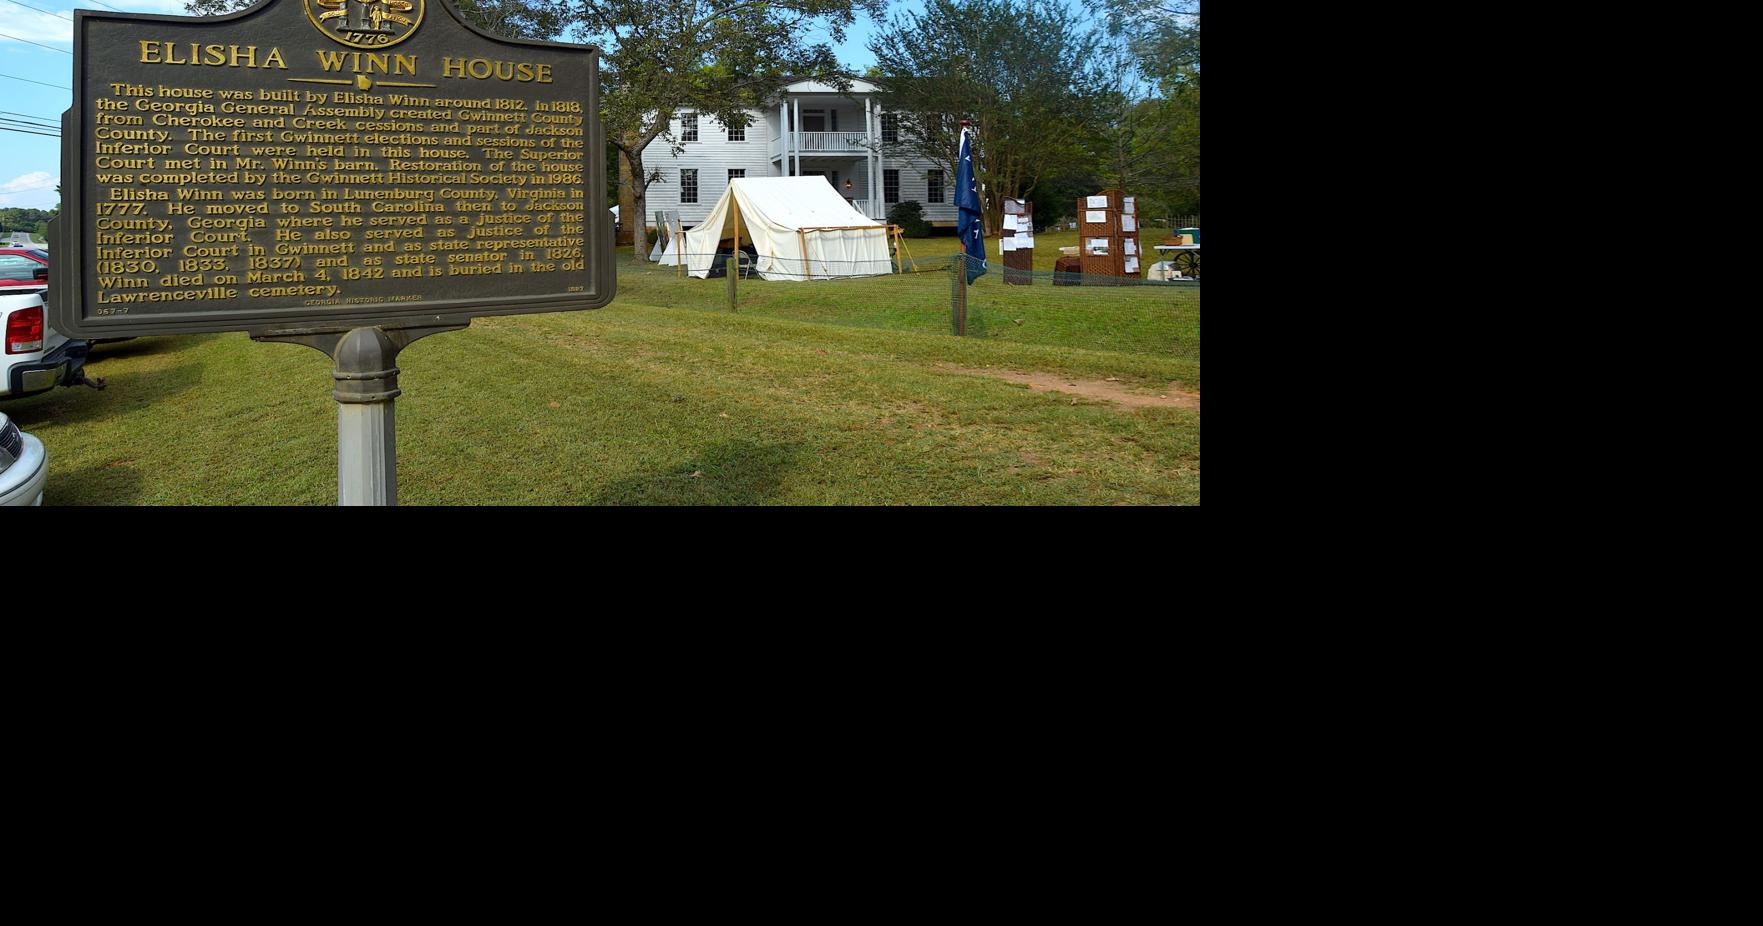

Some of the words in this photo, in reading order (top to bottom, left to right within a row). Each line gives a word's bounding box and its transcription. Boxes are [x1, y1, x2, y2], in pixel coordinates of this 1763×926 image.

[344, 32, 388, 44] 1776
[139, 40, 288, 69] ELISHA
[316, 50, 417, 76] WINN
[443, 57, 553, 83] HOUSE
[110, 83, 153, 97] This
[160, 85, 213, 98] house
[219, 90, 252, 100] was
[259, 89, 300, 102] built
[306, 91, 327, 104] by
[334, 92, 383, 105] Elisha
[389, 94, 431, 107] Winn
[435, 97, 491, 109] around
[496, 99, 527, 111] 1812.
[536, 101, 551, 111] In
[96, 98, 127, 111] the
[136, 100, 214, 115] Georgia
[221, 102, 294, 115] General
[303, 104, 384, 120] Assembly
[390, 108, 451, 120] created
[458, 110, 527, 123] Gwinnett
[532, 112, 583, 127] County
[96, 112, 143, 125] from
[152, 114, 245, 128] Cherokee
[252, 116, 285, 128] and
[293, 117, 346, 129] Creek
[356, 120, 424, 132] cessions
[431, 121, 459, 133] and
[467, 123, 499, 135] part
[505, 124, 520, 135] of
[526, 125, 583, 136] Jackson
[96, 128, 173, 143] County.
[188, 129, 225, 141] The
[232, 130, 273, 142] first
[280, 131, 359, 144] Gwinnett
[364, 133, 438, 145] elections
[443, 134, 471, 146] and
[477, 135, 535, 147] sessions
[540, 136, 555, 147] of
[561, 138, 583, 148] the
[96, 141, 172, 155] Inferior
[185, 143, 239, 156] Court
[253, 146, 295, 156] were
[307, 144, 344, 157] held
[354, 146, 370, 158] in
[382, 147, 410, 158] this
[420, 148, 469, 159] house.
[483, 149, 513, 159] The
[521, 150, 583, 162] Superior
[96, 156, 155, 169] Court
[165, 158, 200, 169] met
[210, 158, 227, 170] in
[236, 158, 264, 170] Mr.
[272, 158, 327, 170] Winn's
[334, 159, 378, 171] barn.
[390, 159, 481, 172] Restoration
[490, 162, 506, 172] of
[512, 162, 535, 172] the
[542, 162, 583, 172] house
[96, 173, 134, 183] was
[140, 172, 239, 185] completed
[244, 172, 266, 186] by
[272, 172, 300, 183] the
[306, 172, 384, 184] Gwinnett
[388, 172, 465, 185] Historical
[470, 174, 526, 186] Society
[531, 174, 544, 184] in
[548, 174, 584, 184] 1986.
[110, 188, 169, 201] Elisha
[177, 188, 223, 200] Winn
[232, 190, 264, 200] was
[272, 188, 316, 200] born
[321, 189, 337, 200] in
[343, 188, 434, 202] Lunenburg
[440, 189, 497, 201] County,
[506, 188, 565, 201] Virginia
[571, 188, 583, 198] in
[96, 202, 147, 216] 1777.
[168, 203, 195, 215] He
[206, 202, 268, 214] moved
[281, 203, 299, 214] to
[310, 201, 361, 214] South
[372, 201, 444, 213] Carolina
[456, 201, 492, 212] then
[502, 202, 516, 211] to
[526, 200, 583, 212] Jackson
[96, 217, 173, 231] County,
[187, 217, 266, 231] Georgia
[277, 216, 333, 228] where
[341, 215, 362, 227] he
[370, 214, 427, 226] served
[435, 215, 452, 224] as
[460, 215, 469, 224] a
[477, 213, 531, 226] justice
[537, 213, 554, 223] of
[560, 213, 583, 222] the
[96, 231, 174, 245] Inferior
[191, 231, 252, 243] Court.
[276, 230, 302, 241] He
[314, 229, 351, 240] also
[366, 228, 423, 240] served
[436, 228, 455, 237] as
[468, 226, 522, 239] justice
[534, 225, 552, 236] of
[560, 225, 583, 234] the
[96, 246, 173, 259] Inferior
[184, 245, 239, 257] Court
[249, 246, 264, 256] in
[276, 243, 354, 256] Gwinnett
[364, 240, 396, 252] and
[404, 241, 421, 251] as
[430, 240, 469, 250] state
[476, 237, 583, 251] representative
[96, 261, 160, 275] (1830,
[249, 258, 301, 270] 1837)
[316, 256, 348, 267] and
[364, 256, 381, 266] as
[396, 254, 436, 264] state
[447, 251, 508, 263] senator
[520, 251, 534, 260] in
[98, 276, 148, 288] Winn
[160, 274, 204, 287] died
[215, 274, 238, 285] on
[248, 271, 305, 284] March
[315, 270, 330, 283] 4,
[343, 268, 384, 280] 1842
[392, 267, 422, 278] and
[430, 267, 443, 276] is
[450, 264, 502, 276] buried
[509, 264, 522, 273] in
[531, 262, 555, 272] the
[562, 261, 584, 271] old
[97, 288, 238, 304] Lawrenceville
[249, 285, 341, 298] cemetery.
[305, 298, 340, 306] GEORGIA
[388, 294, 422, 302] MARKER
